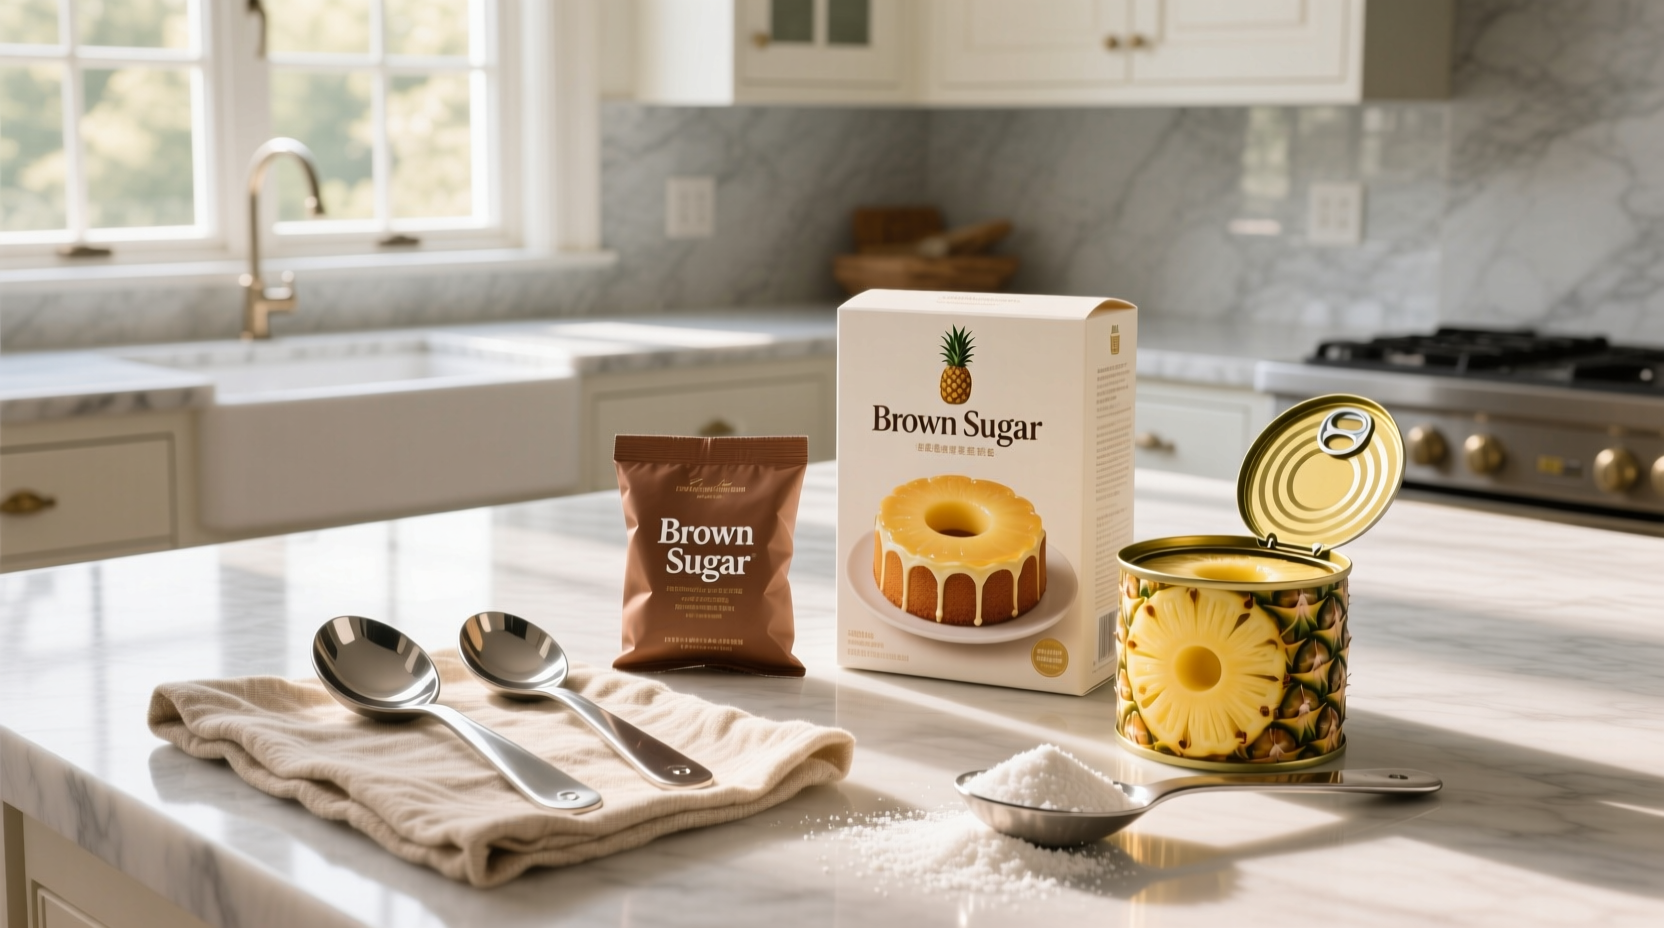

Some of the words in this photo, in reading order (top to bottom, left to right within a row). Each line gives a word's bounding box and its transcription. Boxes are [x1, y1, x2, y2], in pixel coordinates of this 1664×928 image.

[872, 405, 957, 436] Brown
[963, 410, 1043, 448] Sugar
[657, 517, 754, 546] Brown
[666, 547, 751, 583] Sugar
